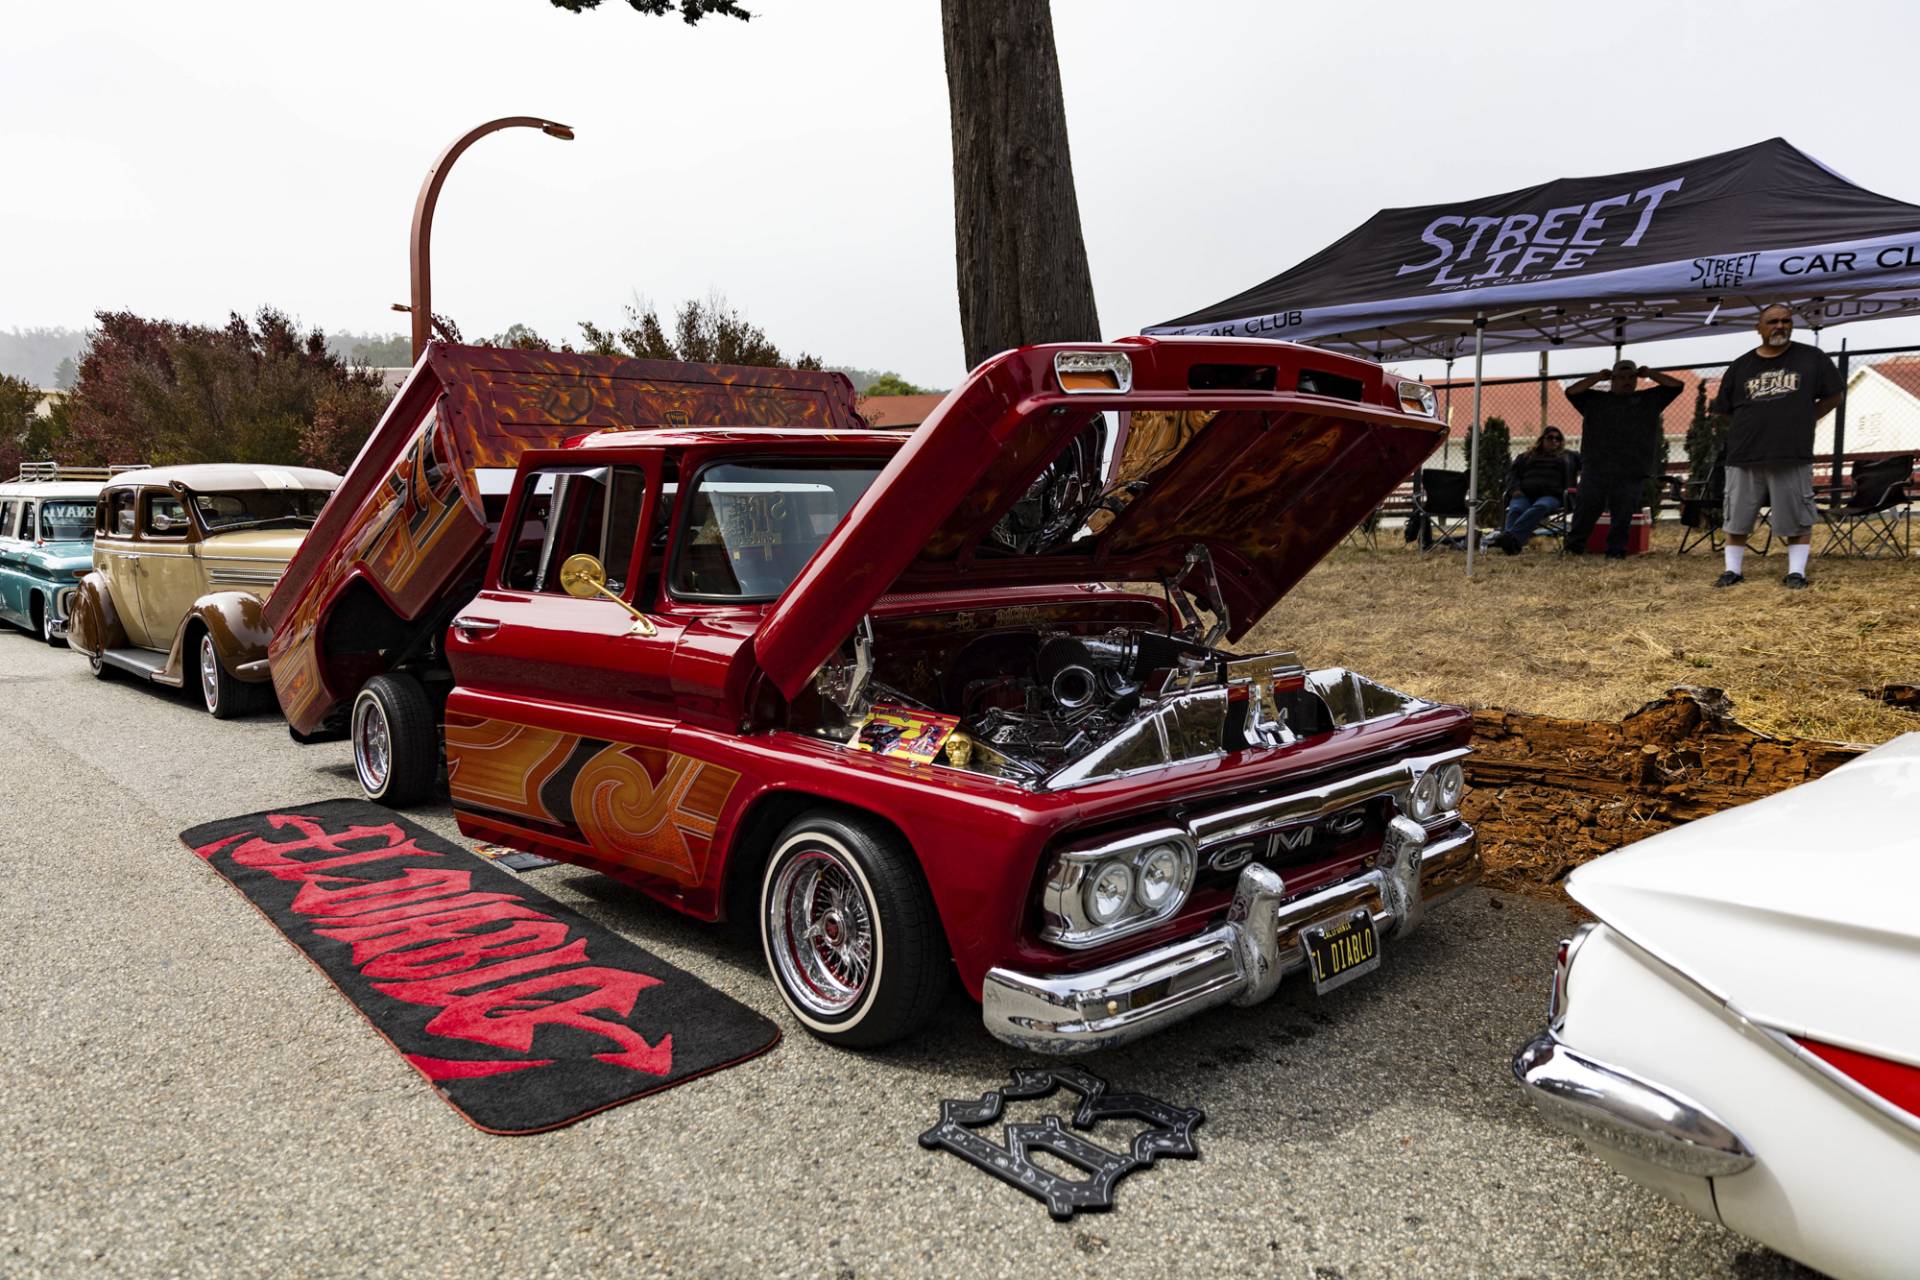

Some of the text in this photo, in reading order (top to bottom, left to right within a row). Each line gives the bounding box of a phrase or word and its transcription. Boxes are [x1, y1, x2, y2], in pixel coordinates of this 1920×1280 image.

[1396, 177, 1685, 276] STREET
[1426, 248, 1597, 287] LIFE
[1691, 253, 1760, 282] STREET
[1702, 273, 1743, 289] LIFE
[1779, 253, 1857, 275] CAR
[1244, 310, 1303, 334] CLUB
[1208, 808, 1366, 871] GMC
[1331, 928, 1373, 974] DIABLO
